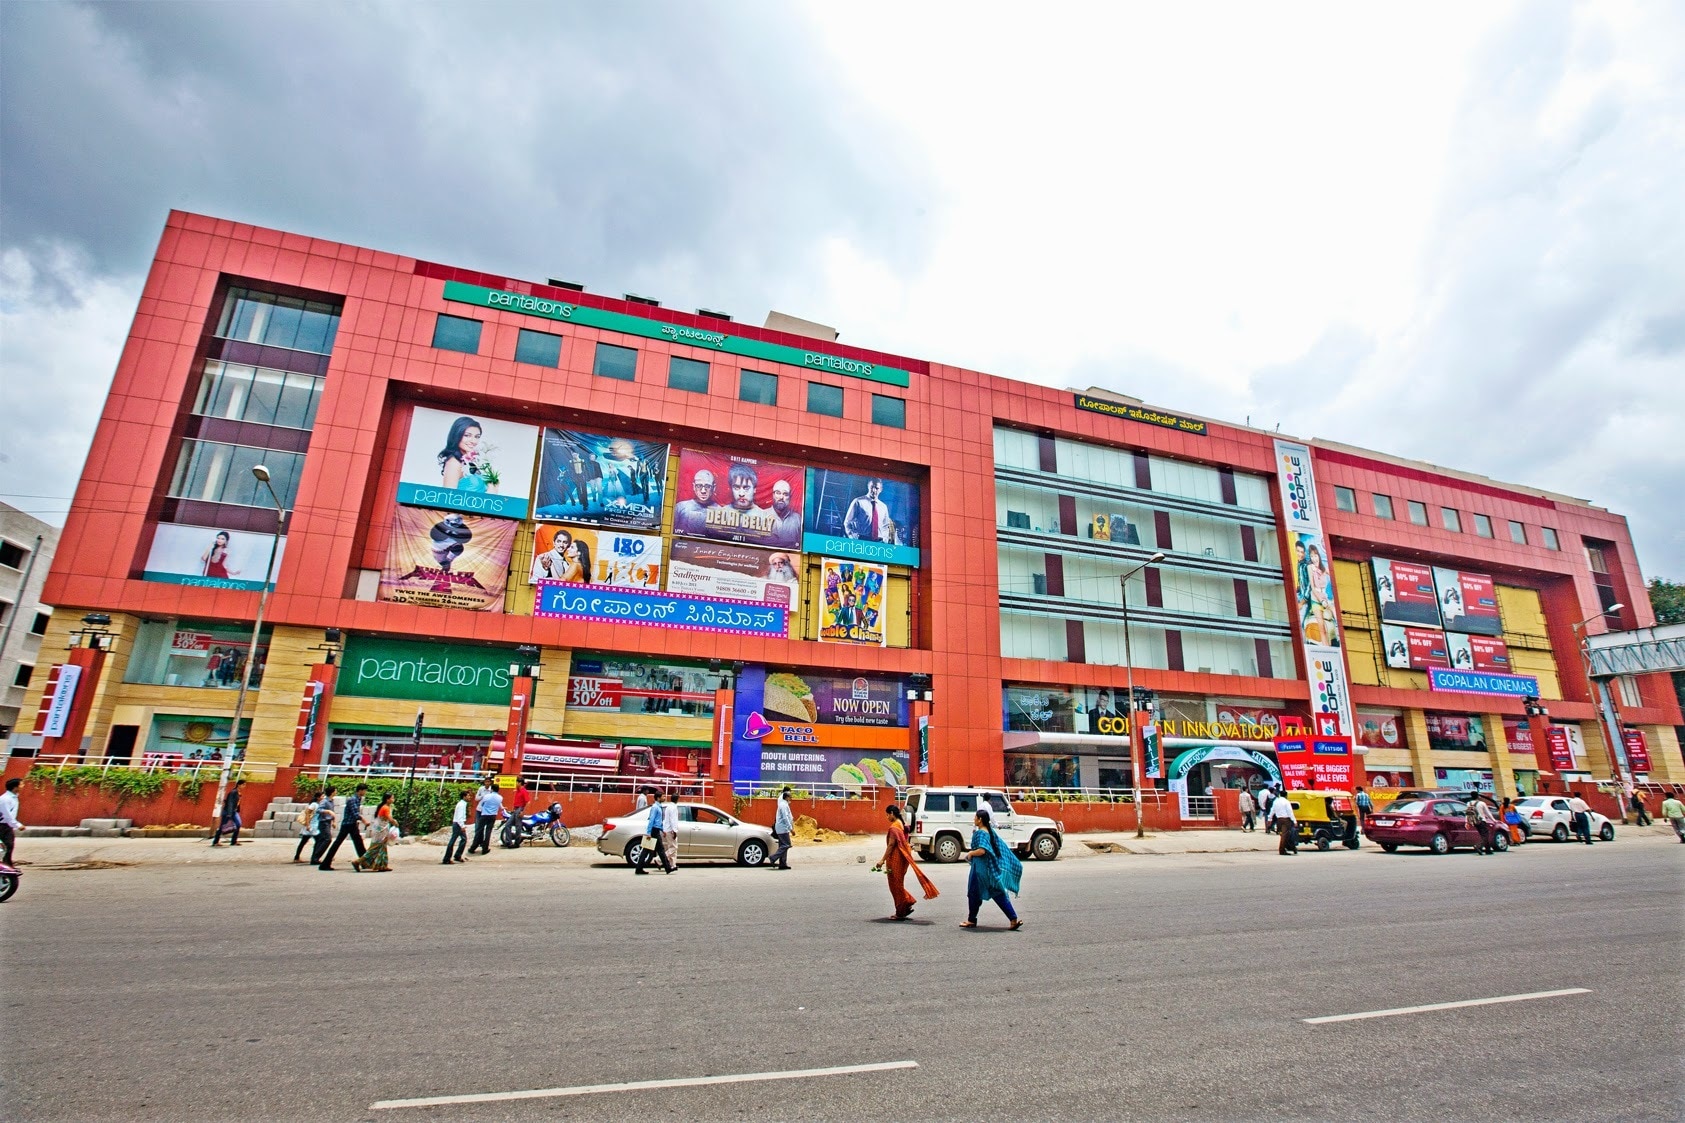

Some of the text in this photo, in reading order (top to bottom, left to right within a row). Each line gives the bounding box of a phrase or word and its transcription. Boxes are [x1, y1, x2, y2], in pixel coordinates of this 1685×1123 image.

[487, 290, 572, 318] pantaloons
[804, 352, 872, 376] pantaloons
[1290, 456, 1310, 521] PEOPLE
[414, 489, 503, 512] pantaloons
[705, 510, 740, 527] DELHI
[742, 514, 776, 532] BELLY
[614, 537, 644, 554] 180
[694, 546, 760, 562] Inner Engineering
[826, 540, 893, 558] pantaloons
[672, 570, 711, 581] Sadhguru
[432, 593, 485, 603] AWESOMENESS
[552, 590, 774, 628] ಗೋಪಾಲನ್ ಸಿನಿಮಾಸ್
[178, 632, 197, 640] SALE
[358, 657, 510, 688] pantaloons
[573, 678, 601, 691] SALE
[1438, 673, 1534, 693] GOPALAN CINEMAS
[50, 674, 72, 730] pantaloons
[833, 698, 890, 715] NOW OPEN
[835, 715, 844, 724] Try
[1182, 721, 1275, 740] INNOVATION
[343, 738, 379, 754] SAE
[1147, 736, 1156, 767] SALE
[761, 752, 827, 762] MOUTH WATERING.
[761, 762, 824, 773] EAR SHATTERING.
[1178, 760, 1192, 776] SALE
[1313, 764, 1350, 773] THE BIGGEST
[1316, 774, 1331, 782] SALE
